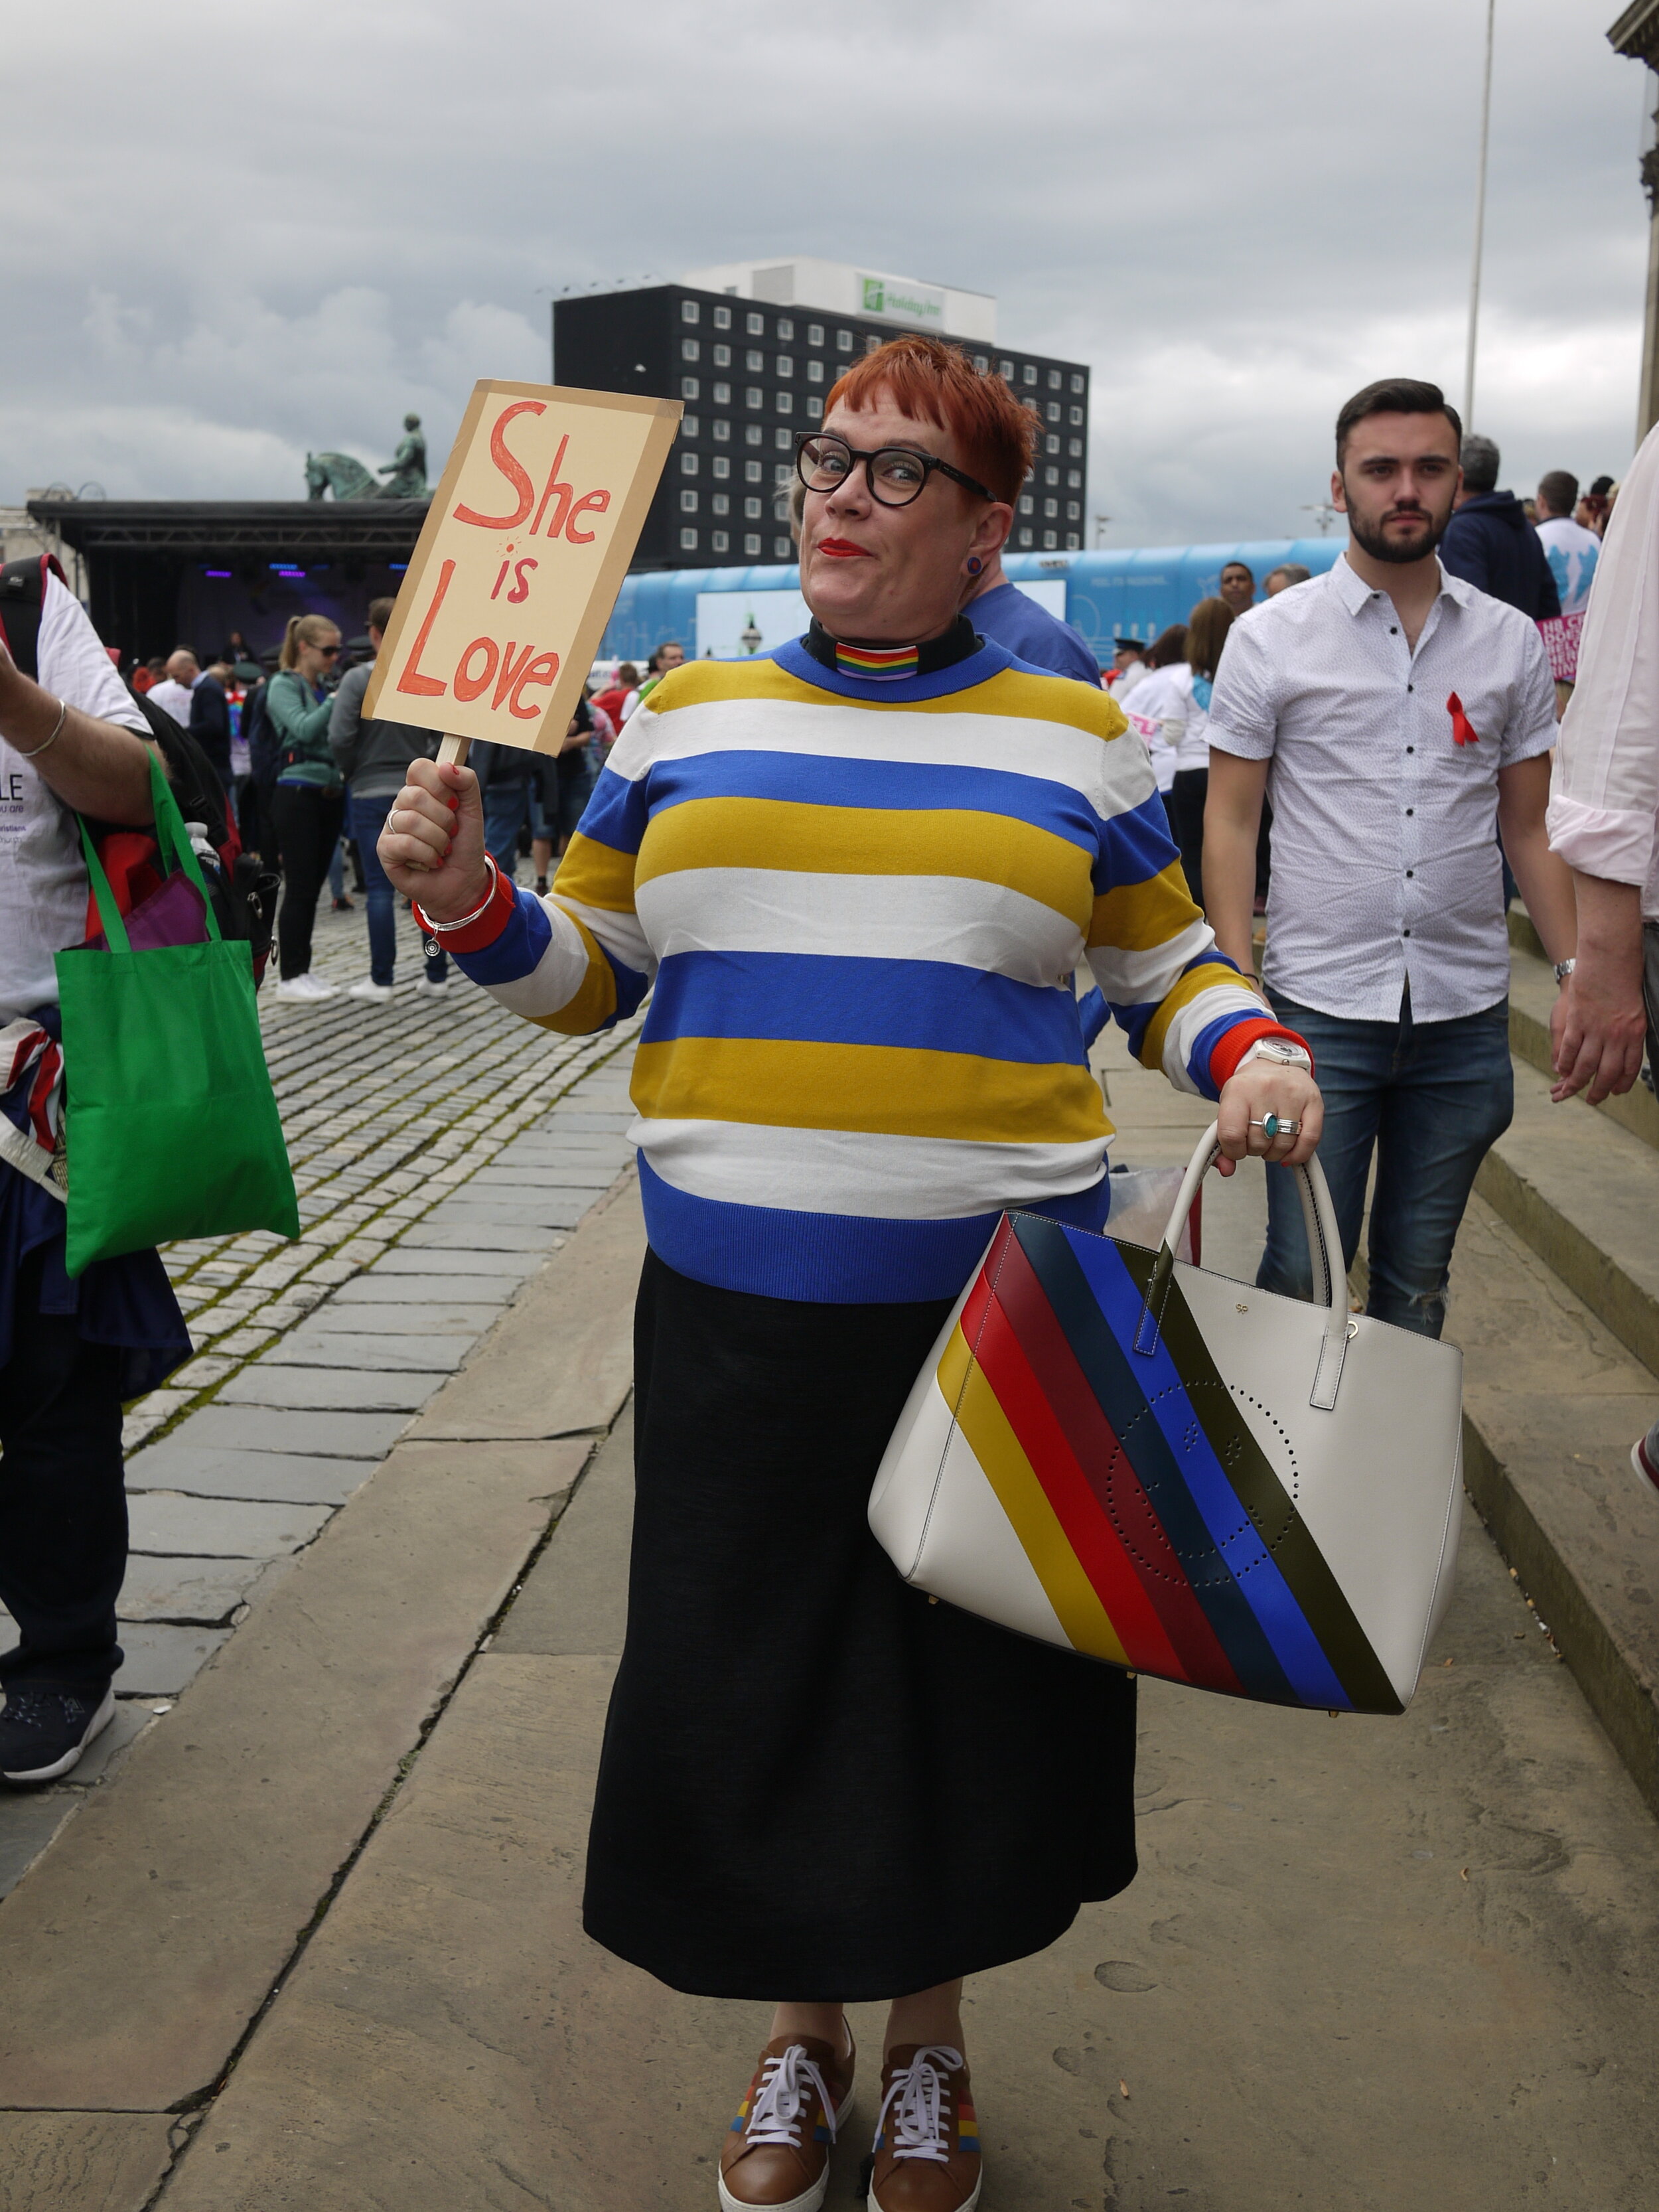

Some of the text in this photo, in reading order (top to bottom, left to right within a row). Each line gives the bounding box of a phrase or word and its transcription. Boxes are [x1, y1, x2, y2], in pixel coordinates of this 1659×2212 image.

[453, 401, 611, 544] She
[396, 559, 559, 719] Love
[490, 536, 538, 604] is
